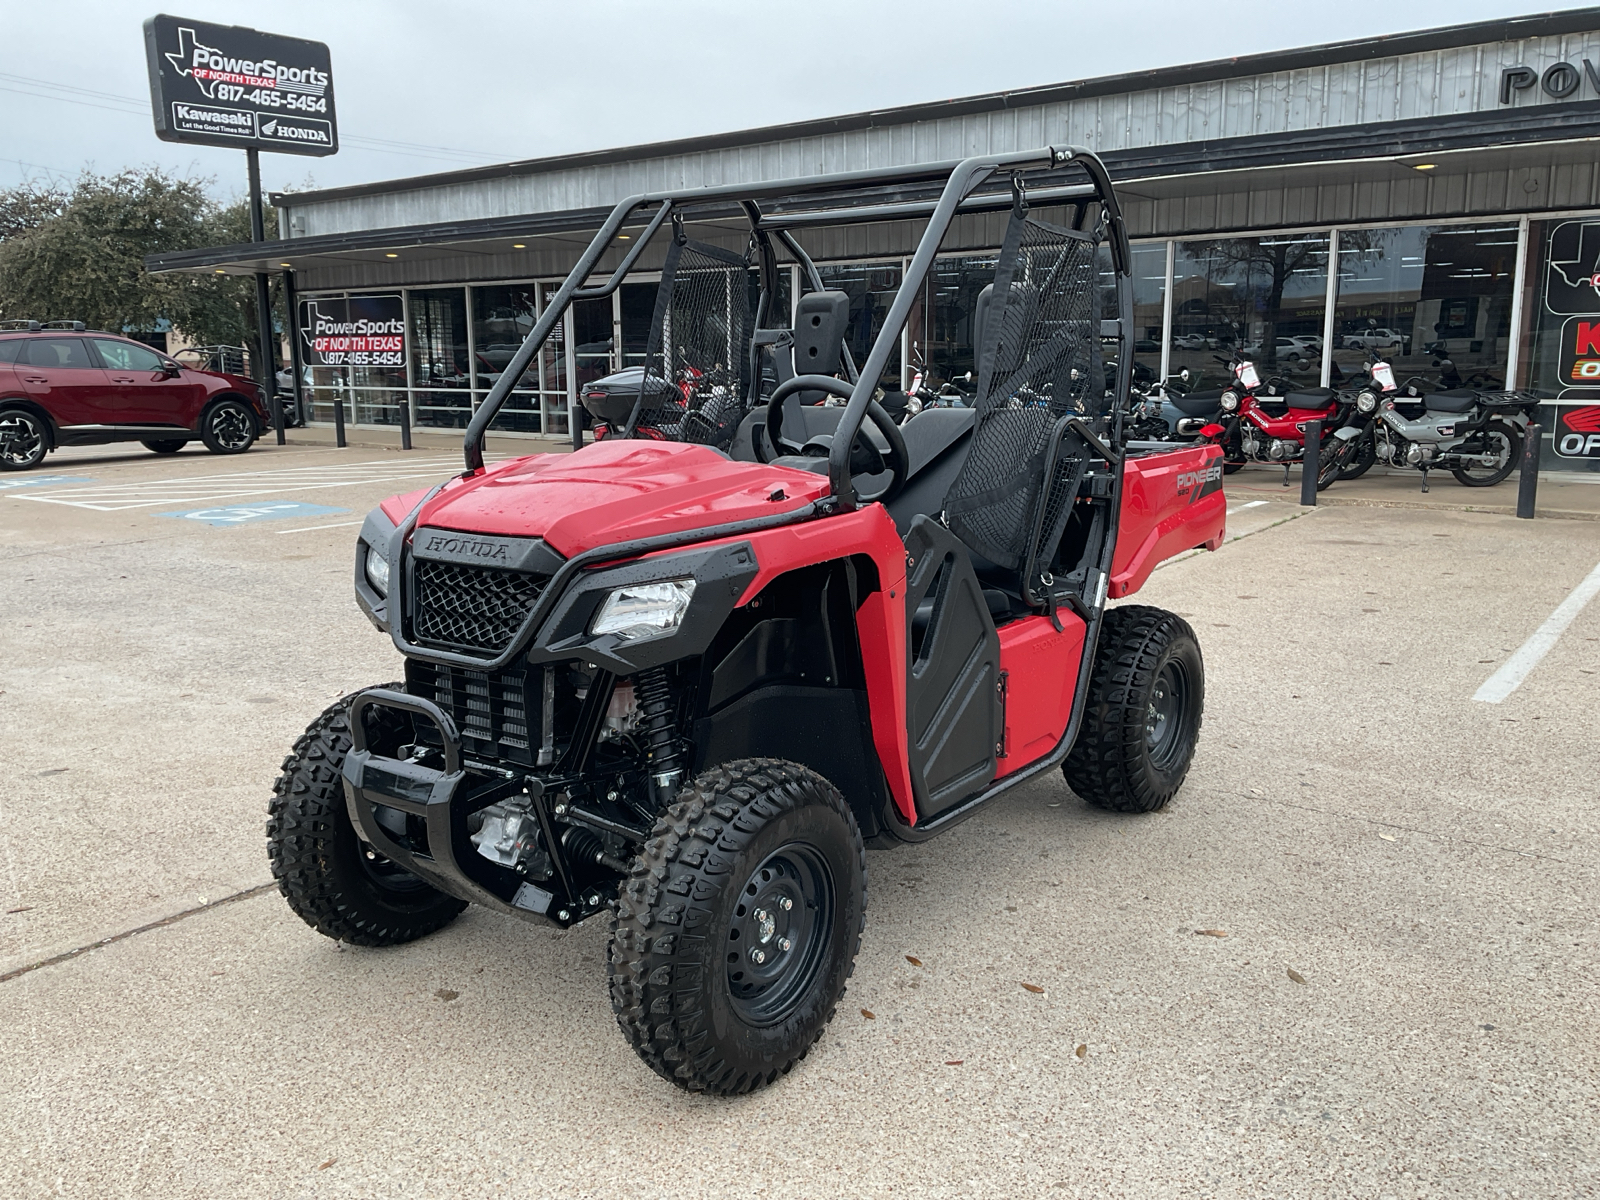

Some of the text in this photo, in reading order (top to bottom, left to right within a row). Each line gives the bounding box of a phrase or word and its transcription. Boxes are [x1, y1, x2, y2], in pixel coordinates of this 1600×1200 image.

[193, 49, 328, 87] PowerSports
[194, 69, 275, 88] OF NORTH TEXAS
[217, 84, 327, 113] 817-465-5454
[177, 105, 252, 126] Kawasaki
[277, 126, 328, 142] HONDA
[315, 319, 404, 336] PowerSports
[315, 338, 329, 350] OF
[367, 337, 401, 350] TEXAS
[1249, 410, 1269, 429] HONDA
[1385, 412, 1407, 432] HONDA
[1177, 466, 1221, 489] PIONEER
[425, 536, 510, 560] HONDA
